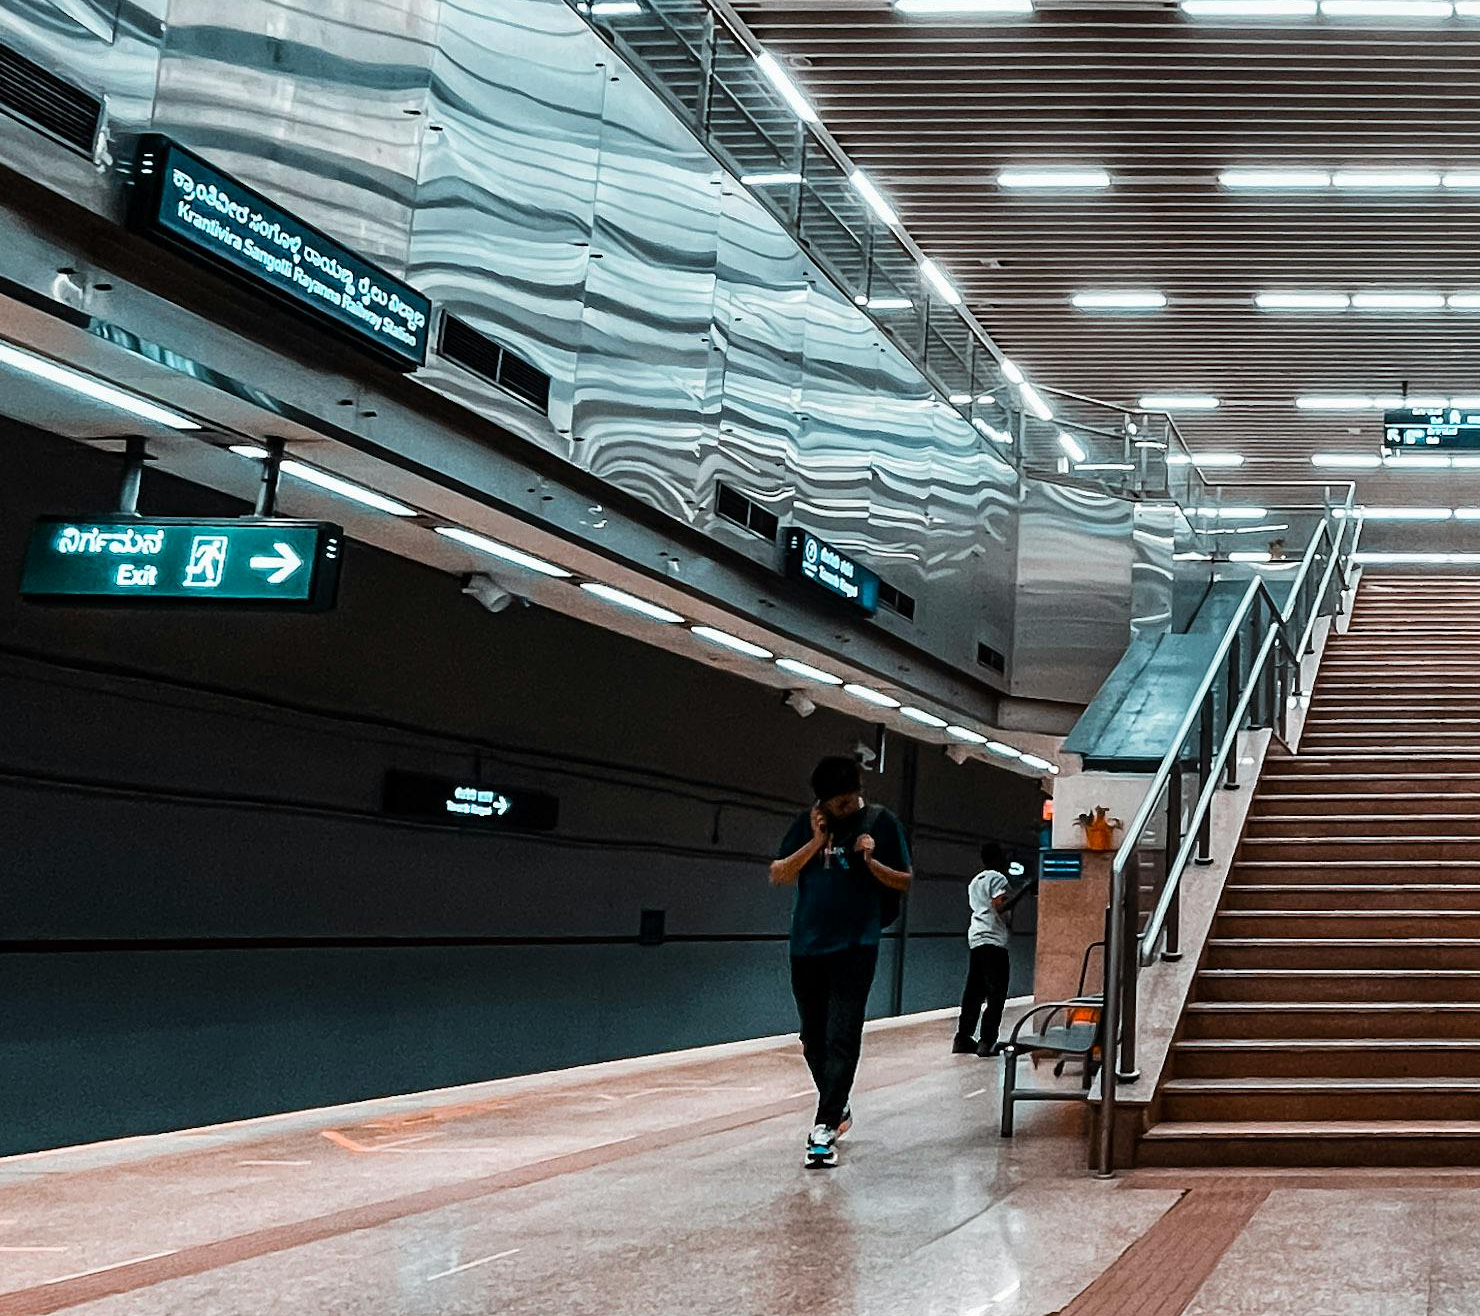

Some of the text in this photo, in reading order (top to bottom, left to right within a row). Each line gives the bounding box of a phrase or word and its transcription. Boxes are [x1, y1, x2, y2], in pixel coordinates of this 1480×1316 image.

[178, 200, 416, 346] Krantivira Sangolli Rayanna Railway Station
[57, 527, 165, 555] ನಿರ್ಗಮನ
[116, 563, 157, 586] Exit
